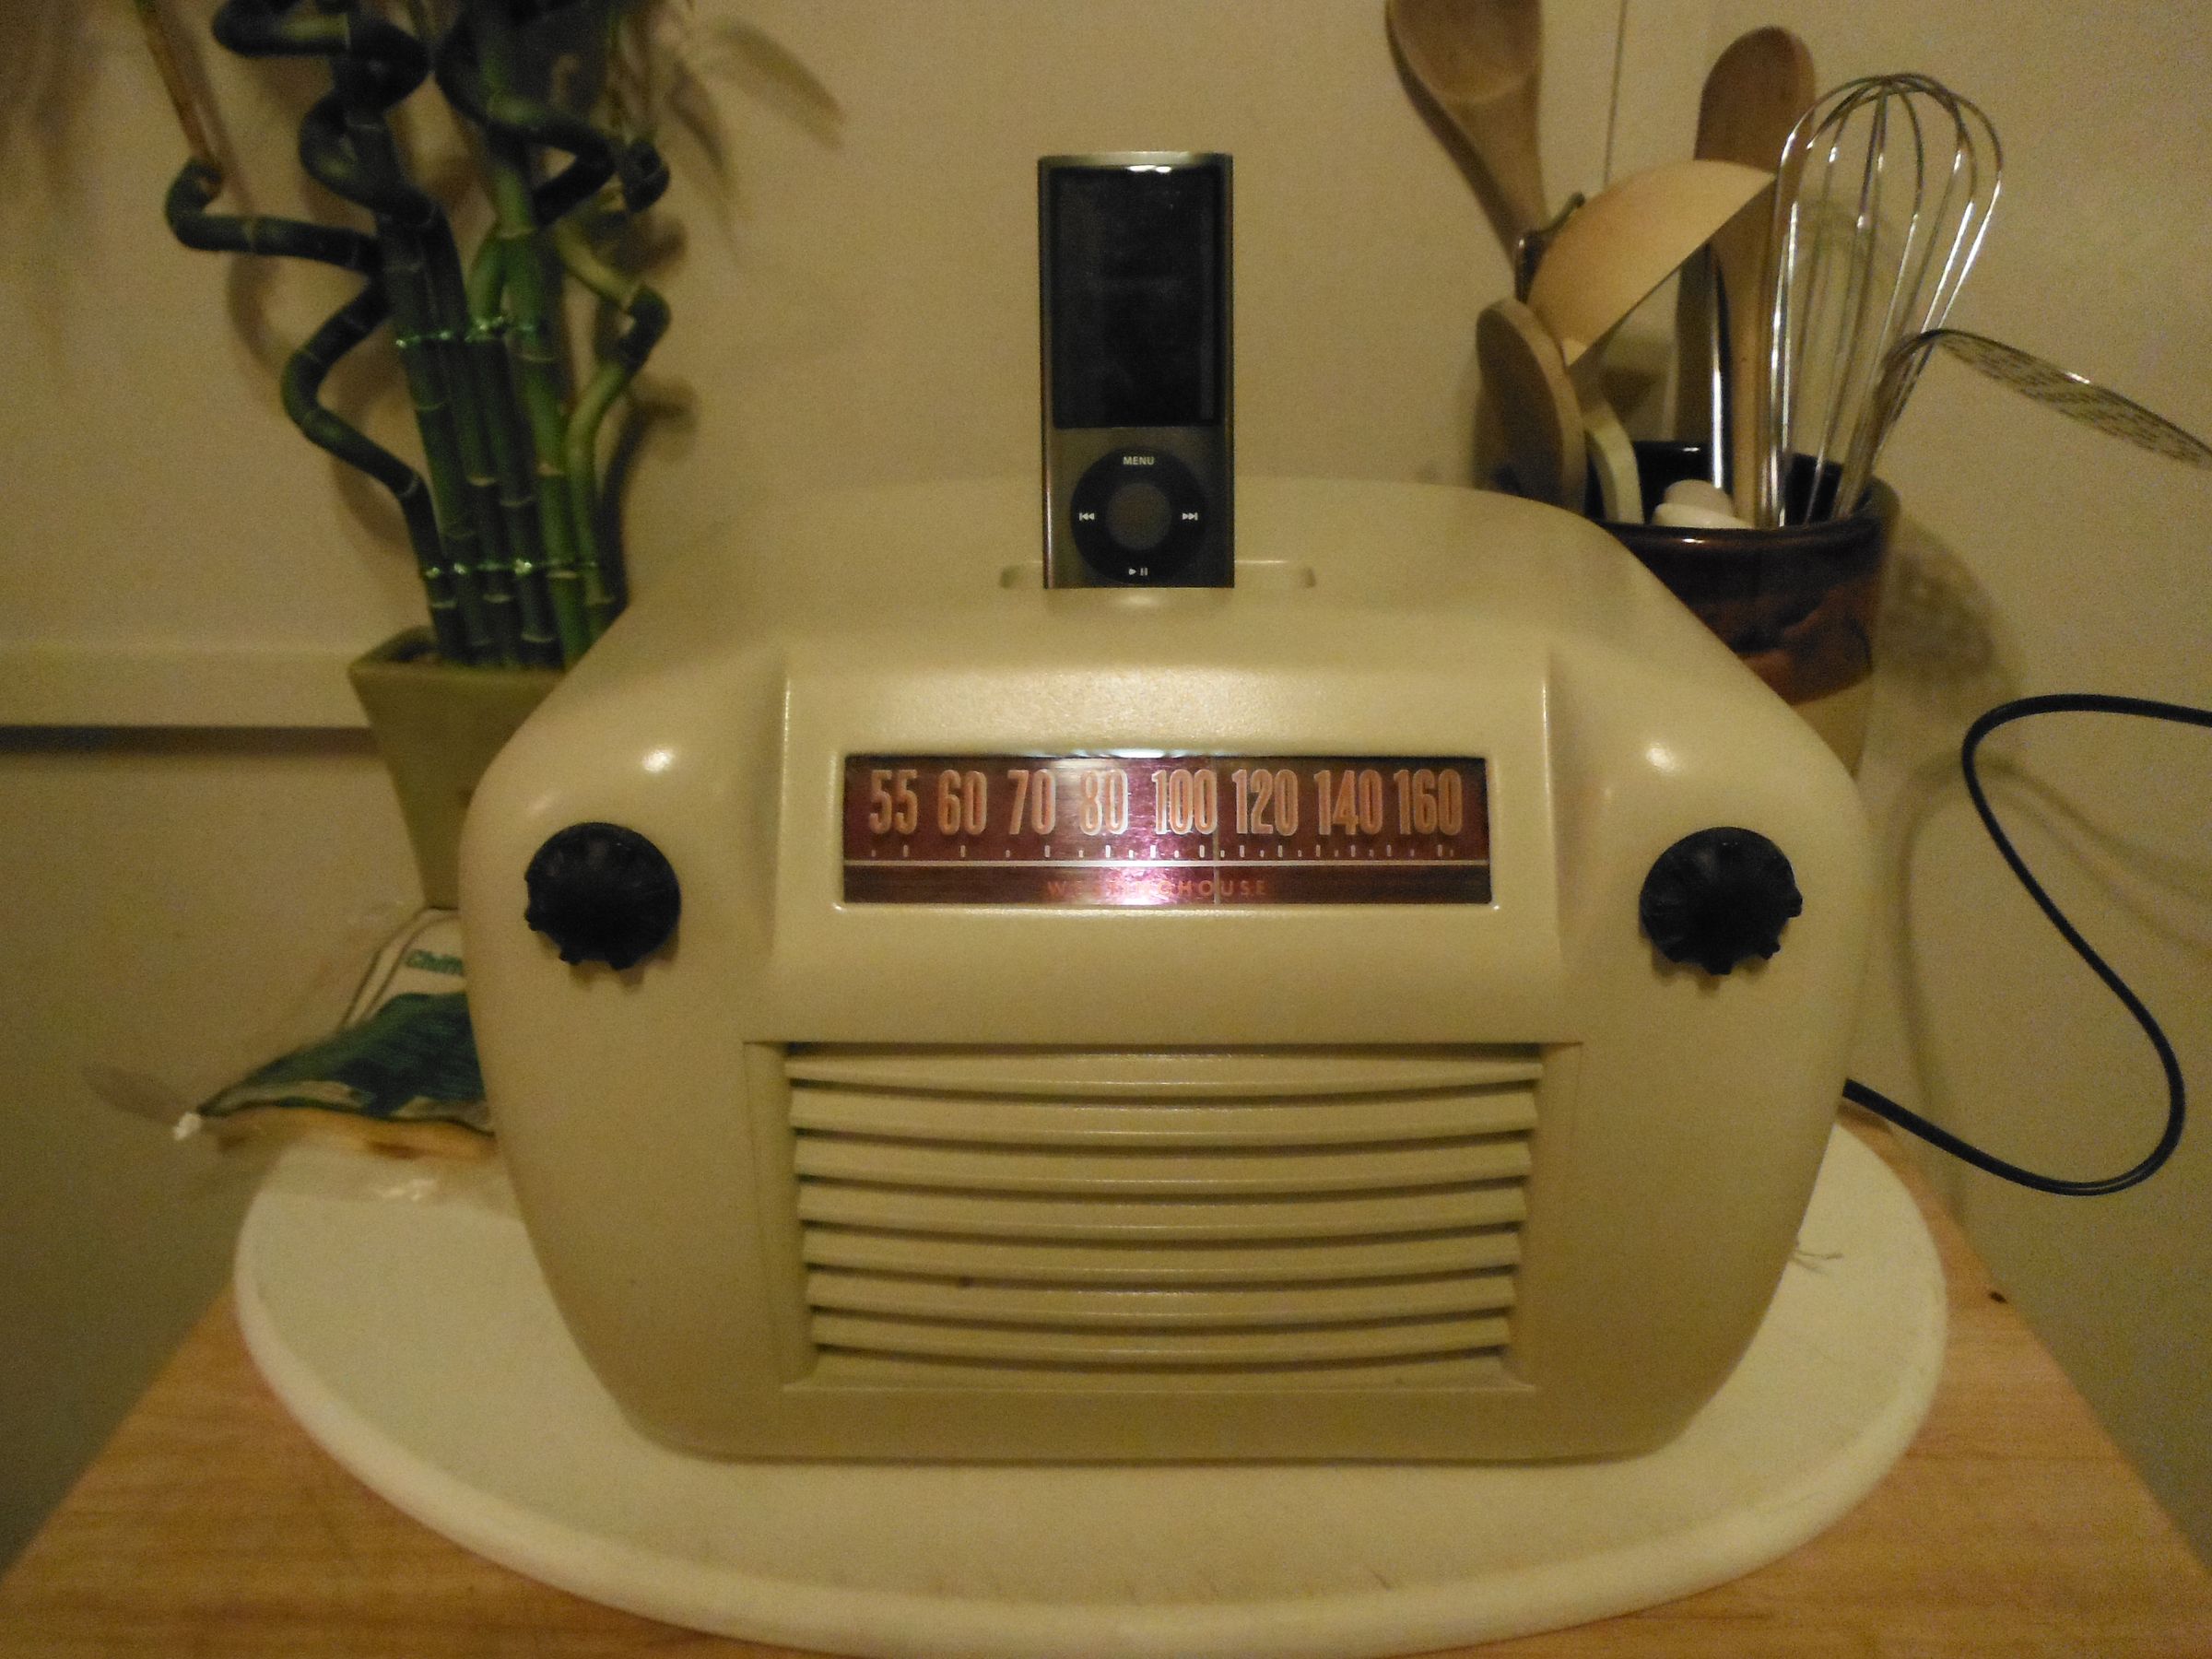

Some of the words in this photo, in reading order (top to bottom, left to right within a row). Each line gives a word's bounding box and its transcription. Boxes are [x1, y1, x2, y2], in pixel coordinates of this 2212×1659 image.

[1123, 455, 1155, 465] MENU
[869, 769, 919, 835] 55
[937, 769, 988, 835] 60
[1007, 769, 1056, 835] 70
[1078, 769, 1129, 835] 80
[1151, 769, 1218, 835] 100
[1231, 769, 1299, 836] 120
[1313, 769, 1382, 835] 140
[1393, 769, 1462, 835] 160
